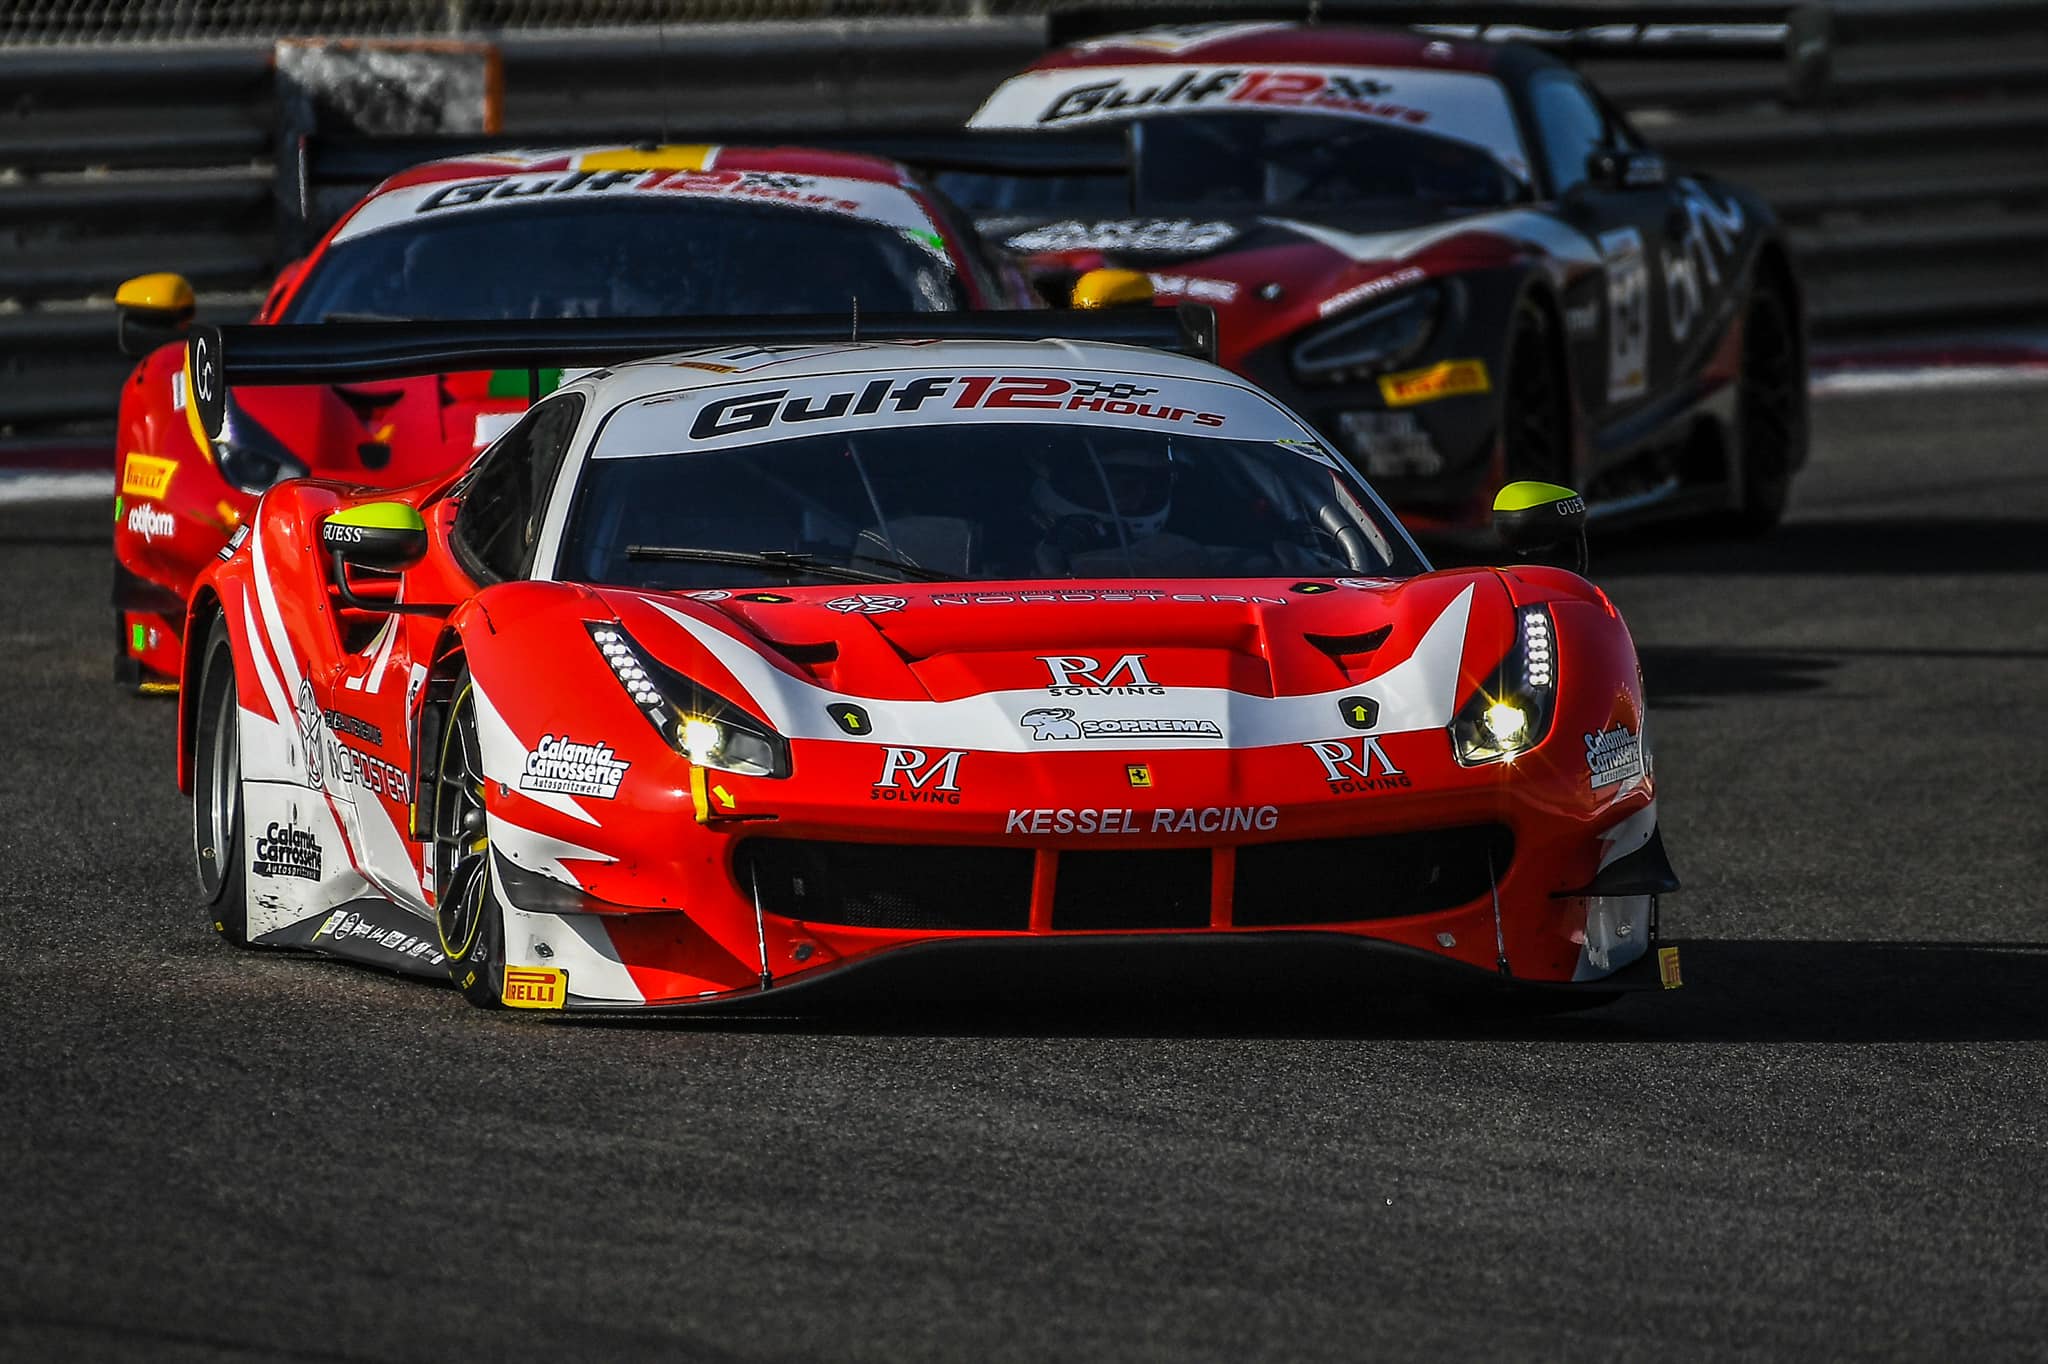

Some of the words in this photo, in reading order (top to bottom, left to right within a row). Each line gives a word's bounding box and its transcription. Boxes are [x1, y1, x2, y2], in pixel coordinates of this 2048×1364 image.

[126, 463, 167, 490] PIRELLI
[127, 502, 175, 543] rotiform
[323, 524, 363, 543] GUESS
[932, 593, 1288, 606] NORDSTERN
[1050, 687, 1166, 697] SOLVING
[1082, 720, 1219, 733] SOPREMA
[526, 750, 624, 787] Carrosserie
[533, 777, 602, 795] Autospritzwerk
[1329, 776, 1412, 795] SOLVING
[870, 788, 961, 805] SOLVING
[1005, 808, 1140, 834] KESSEL
[1150, 805, 1278, 832] RACING
[505, 971, 555, 1002] PIRELLI
